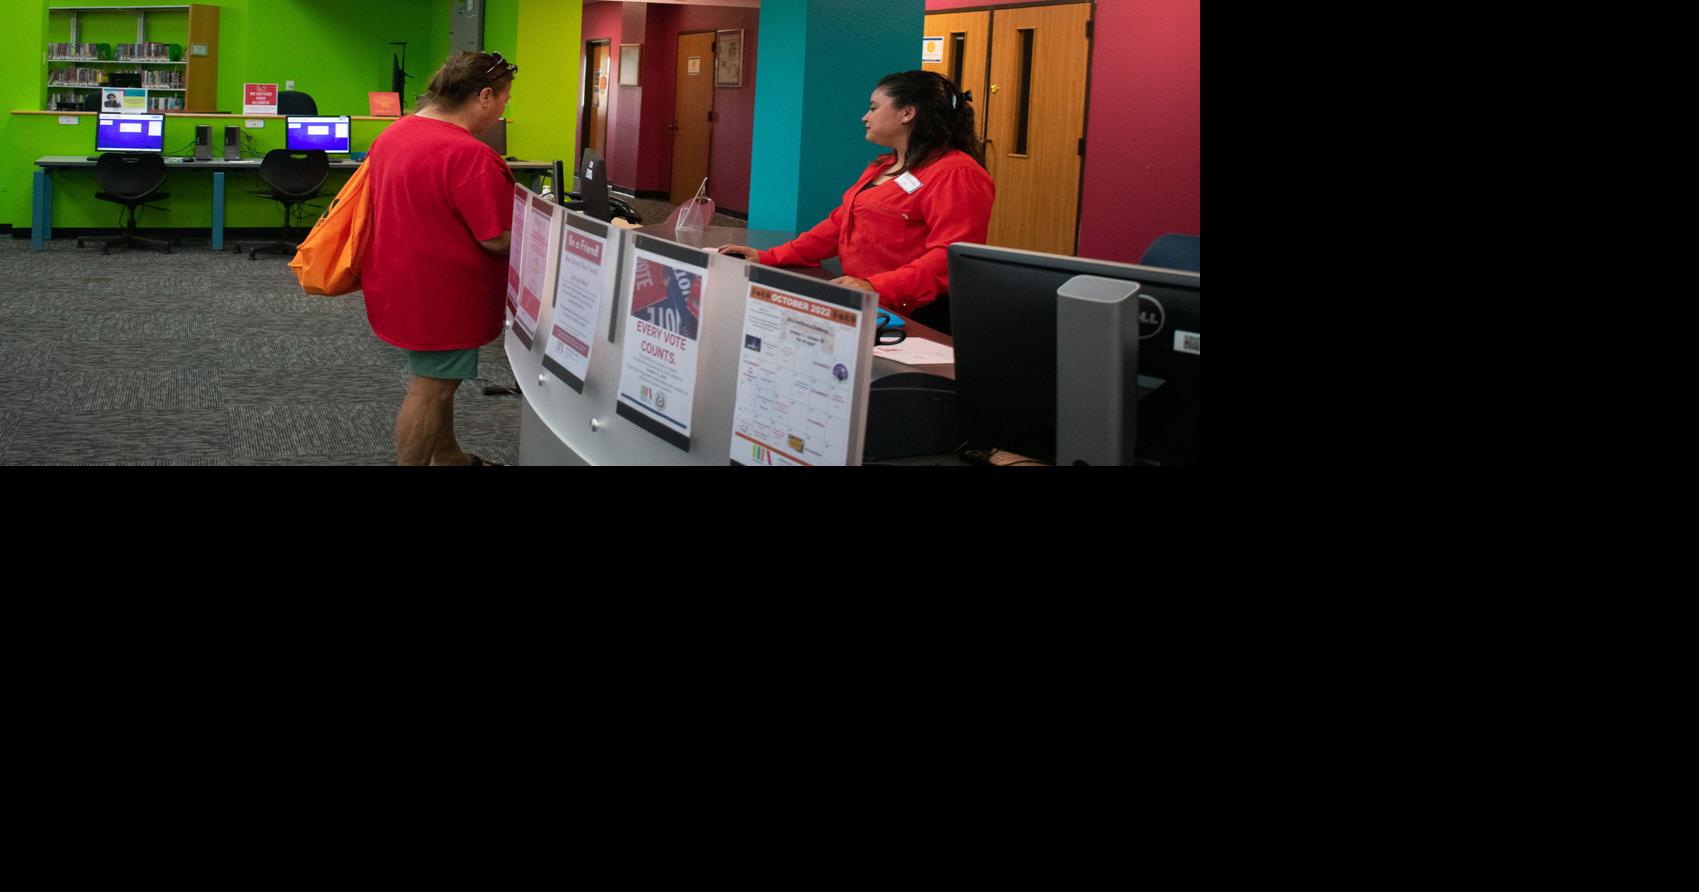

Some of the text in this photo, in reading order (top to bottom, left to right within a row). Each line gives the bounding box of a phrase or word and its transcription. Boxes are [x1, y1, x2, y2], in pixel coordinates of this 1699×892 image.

[771, 294, 832, 317] OCTOBER 2022
[1139, 311, 1159, 325] LL
[636, 320, 687, 351] EVERY VOTE
[640, 340, 677, 366] COUNTS.
